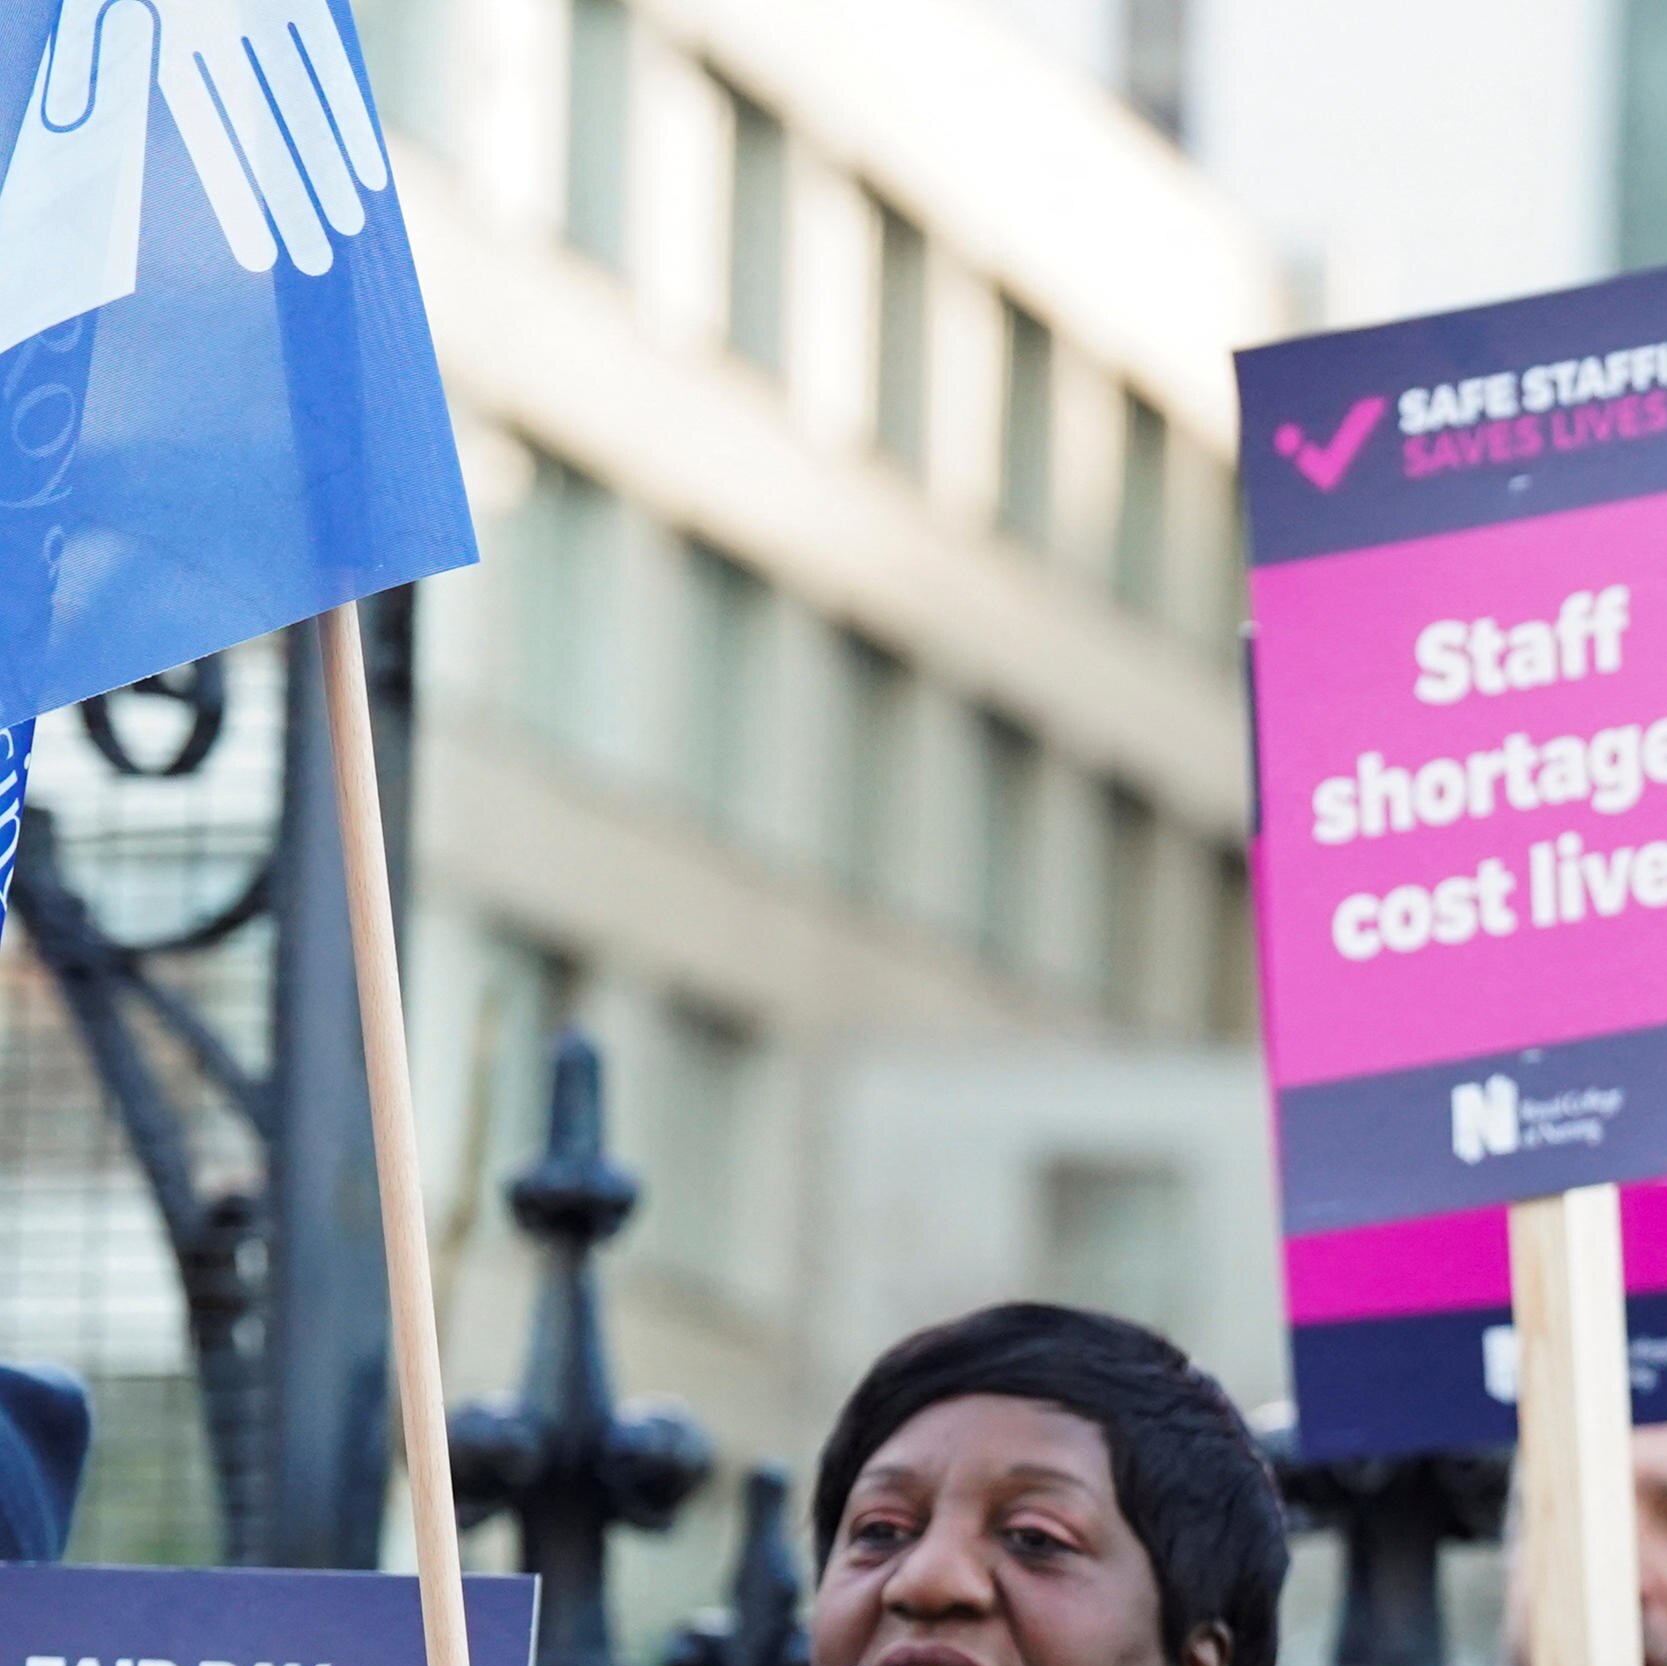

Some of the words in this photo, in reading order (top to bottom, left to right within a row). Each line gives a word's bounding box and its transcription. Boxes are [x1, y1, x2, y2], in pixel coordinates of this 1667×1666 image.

[1398, 371, 1518, 435] SAFE
[1403, 415, 1544, 479] SAVES
[1413, 584, 1632, 706] Staff
[1330, 857, 1519, 962] cost
